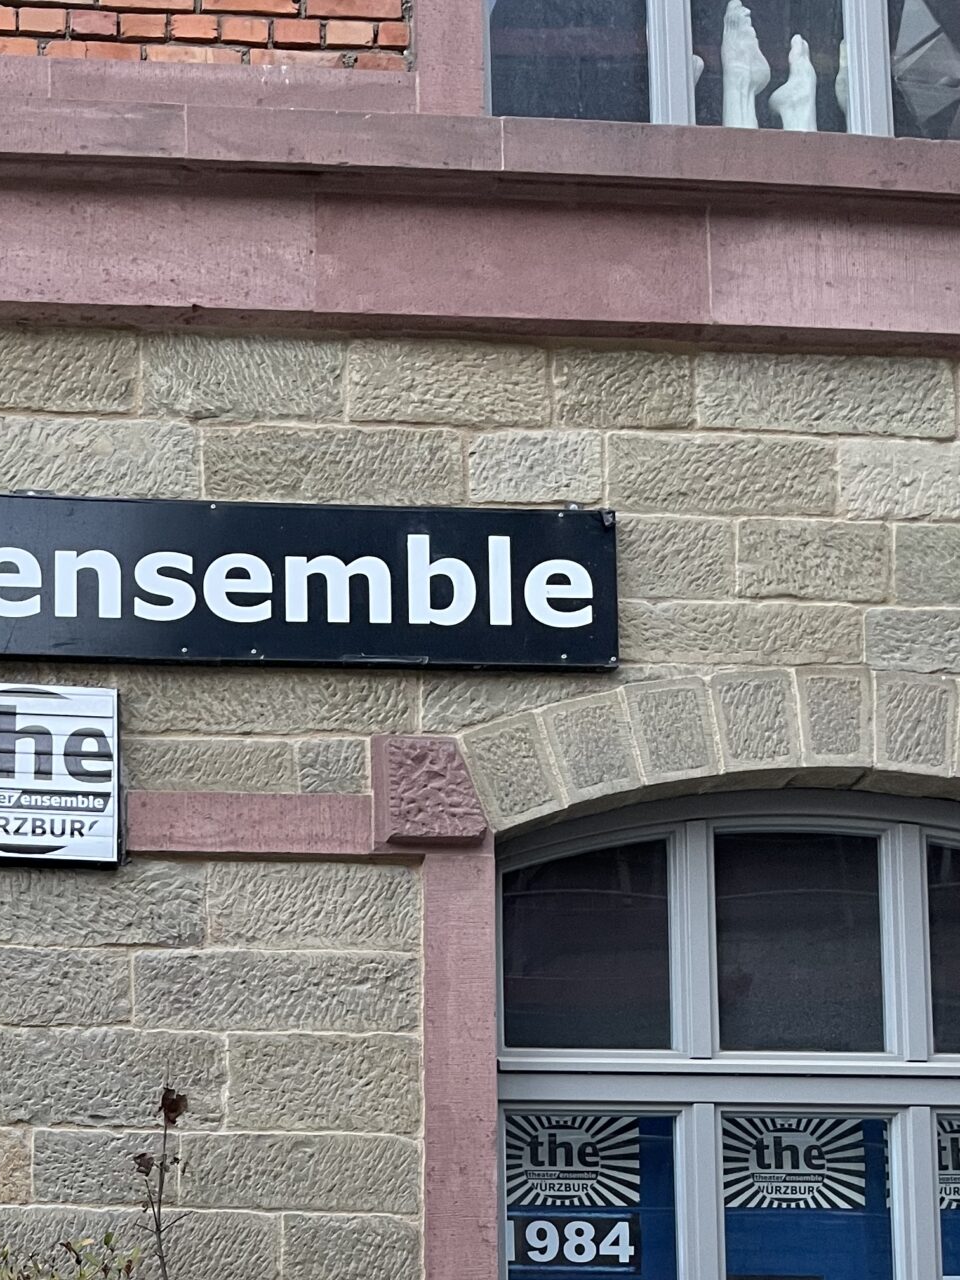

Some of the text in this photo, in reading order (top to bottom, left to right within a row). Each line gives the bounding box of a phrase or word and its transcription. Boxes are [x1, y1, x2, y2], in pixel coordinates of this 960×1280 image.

[20, 794, 104, 808] ensemble
[526, 1133, 600, 1167] the
[752, 1136, 825, 1170] the
